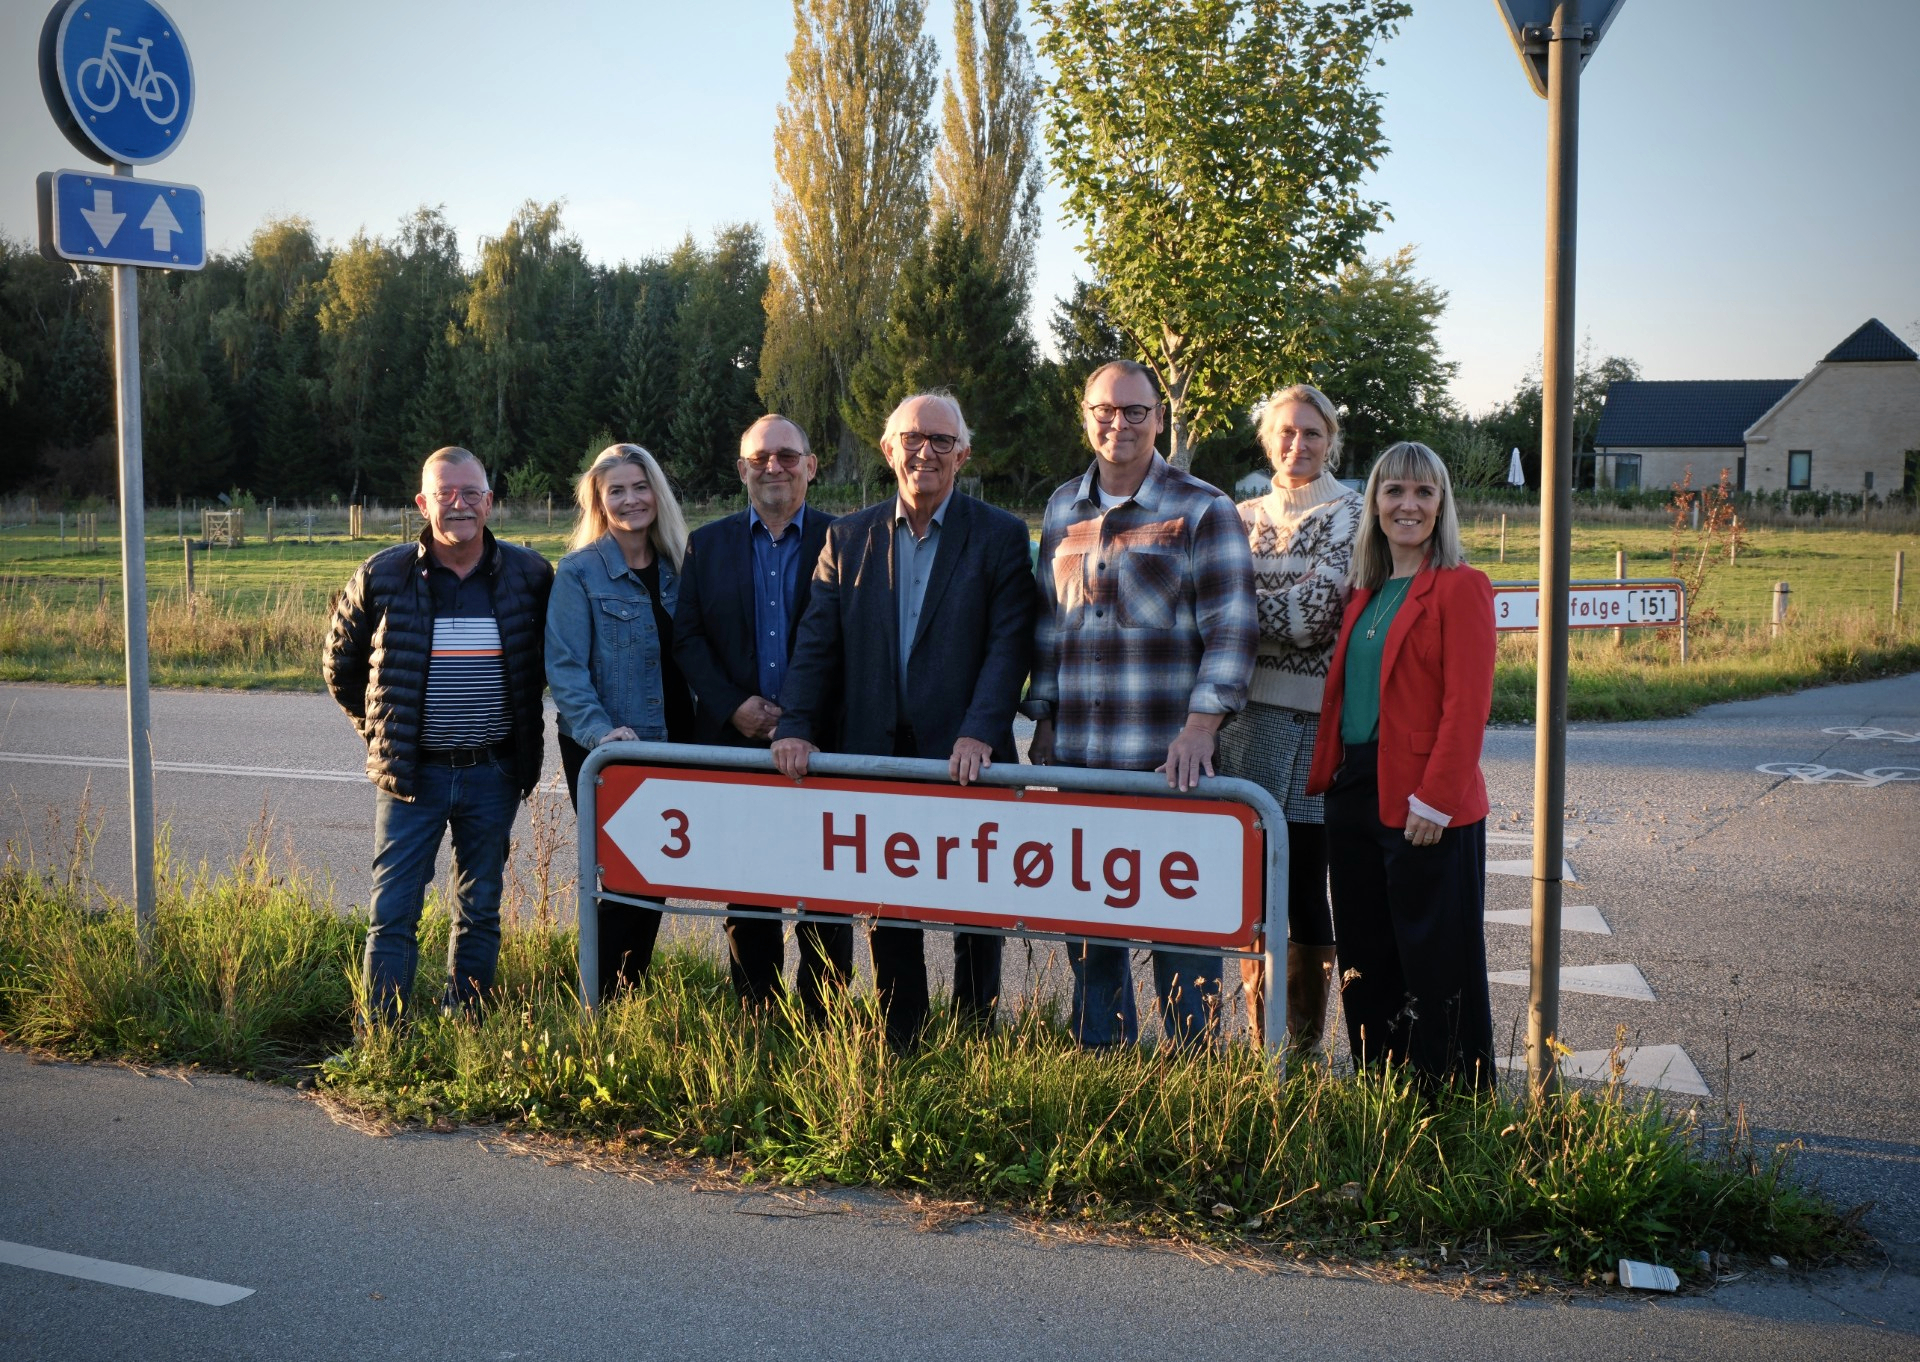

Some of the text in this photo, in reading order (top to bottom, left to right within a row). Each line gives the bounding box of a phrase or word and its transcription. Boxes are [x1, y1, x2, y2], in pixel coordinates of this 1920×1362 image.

[1501, 597, 1666, 620] 3 følge 151
[661, 809, 1199, 908] 3 Herfølge
